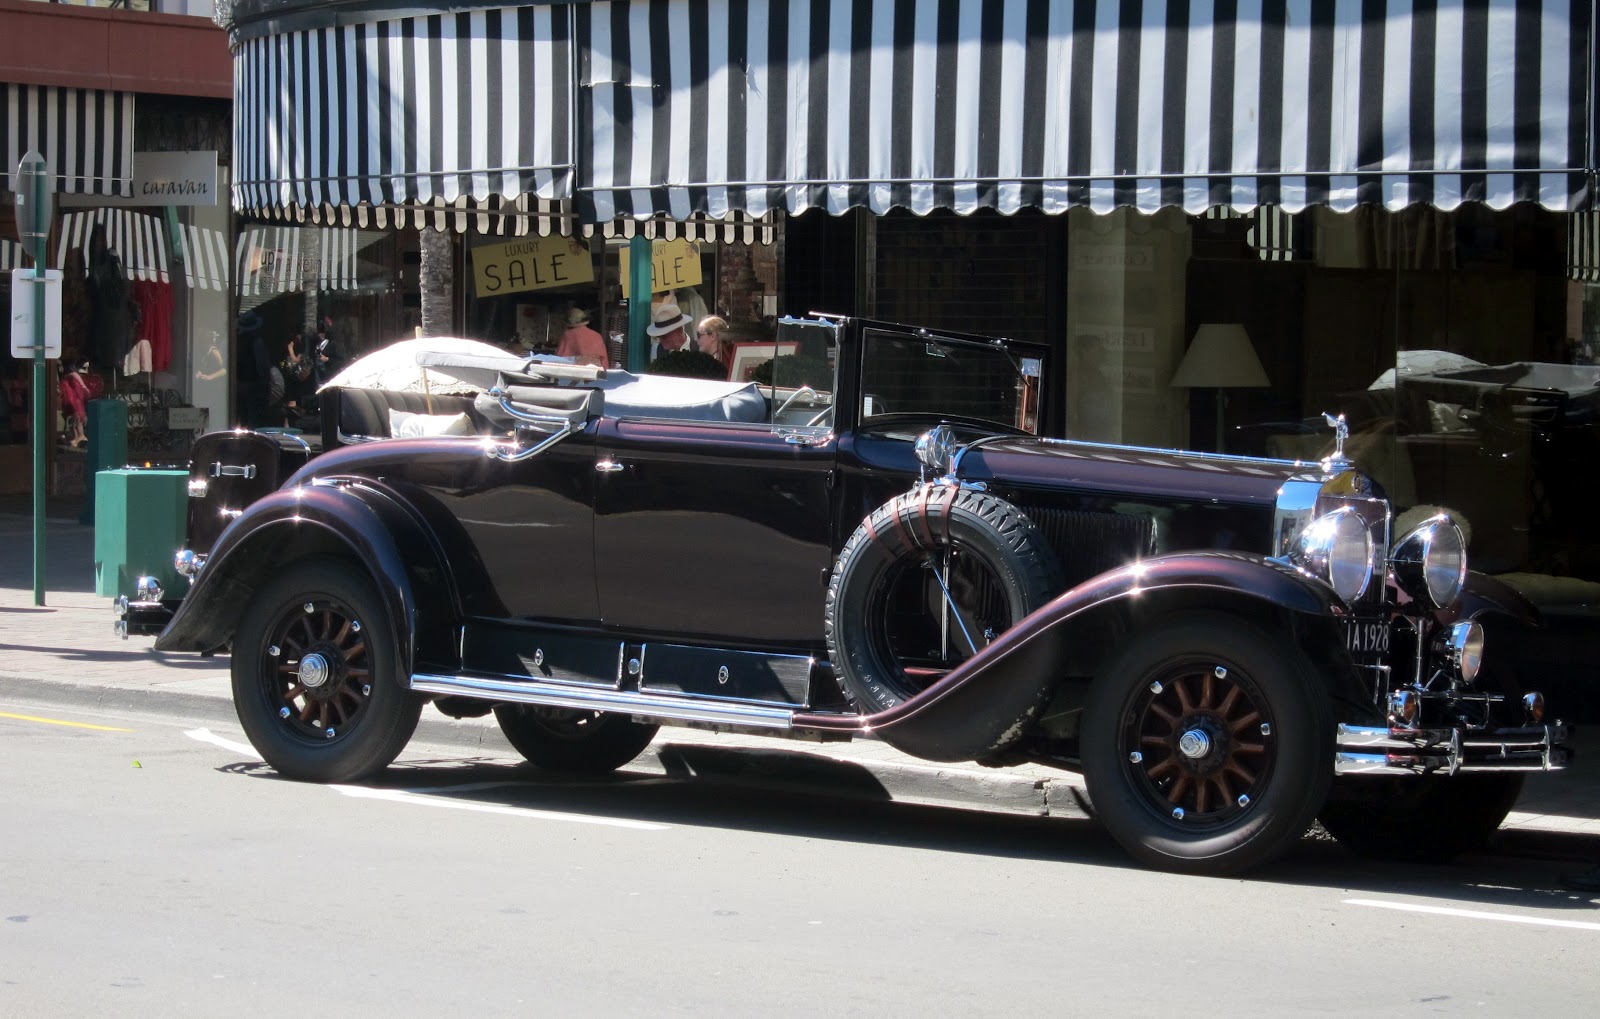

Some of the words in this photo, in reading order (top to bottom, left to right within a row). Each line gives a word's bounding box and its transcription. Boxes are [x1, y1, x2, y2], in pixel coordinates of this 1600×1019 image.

[143, 179, 208, 195] caravan
[504, 241, 540, 257] LUXURY
[484, 253, 568, 292] SALE
